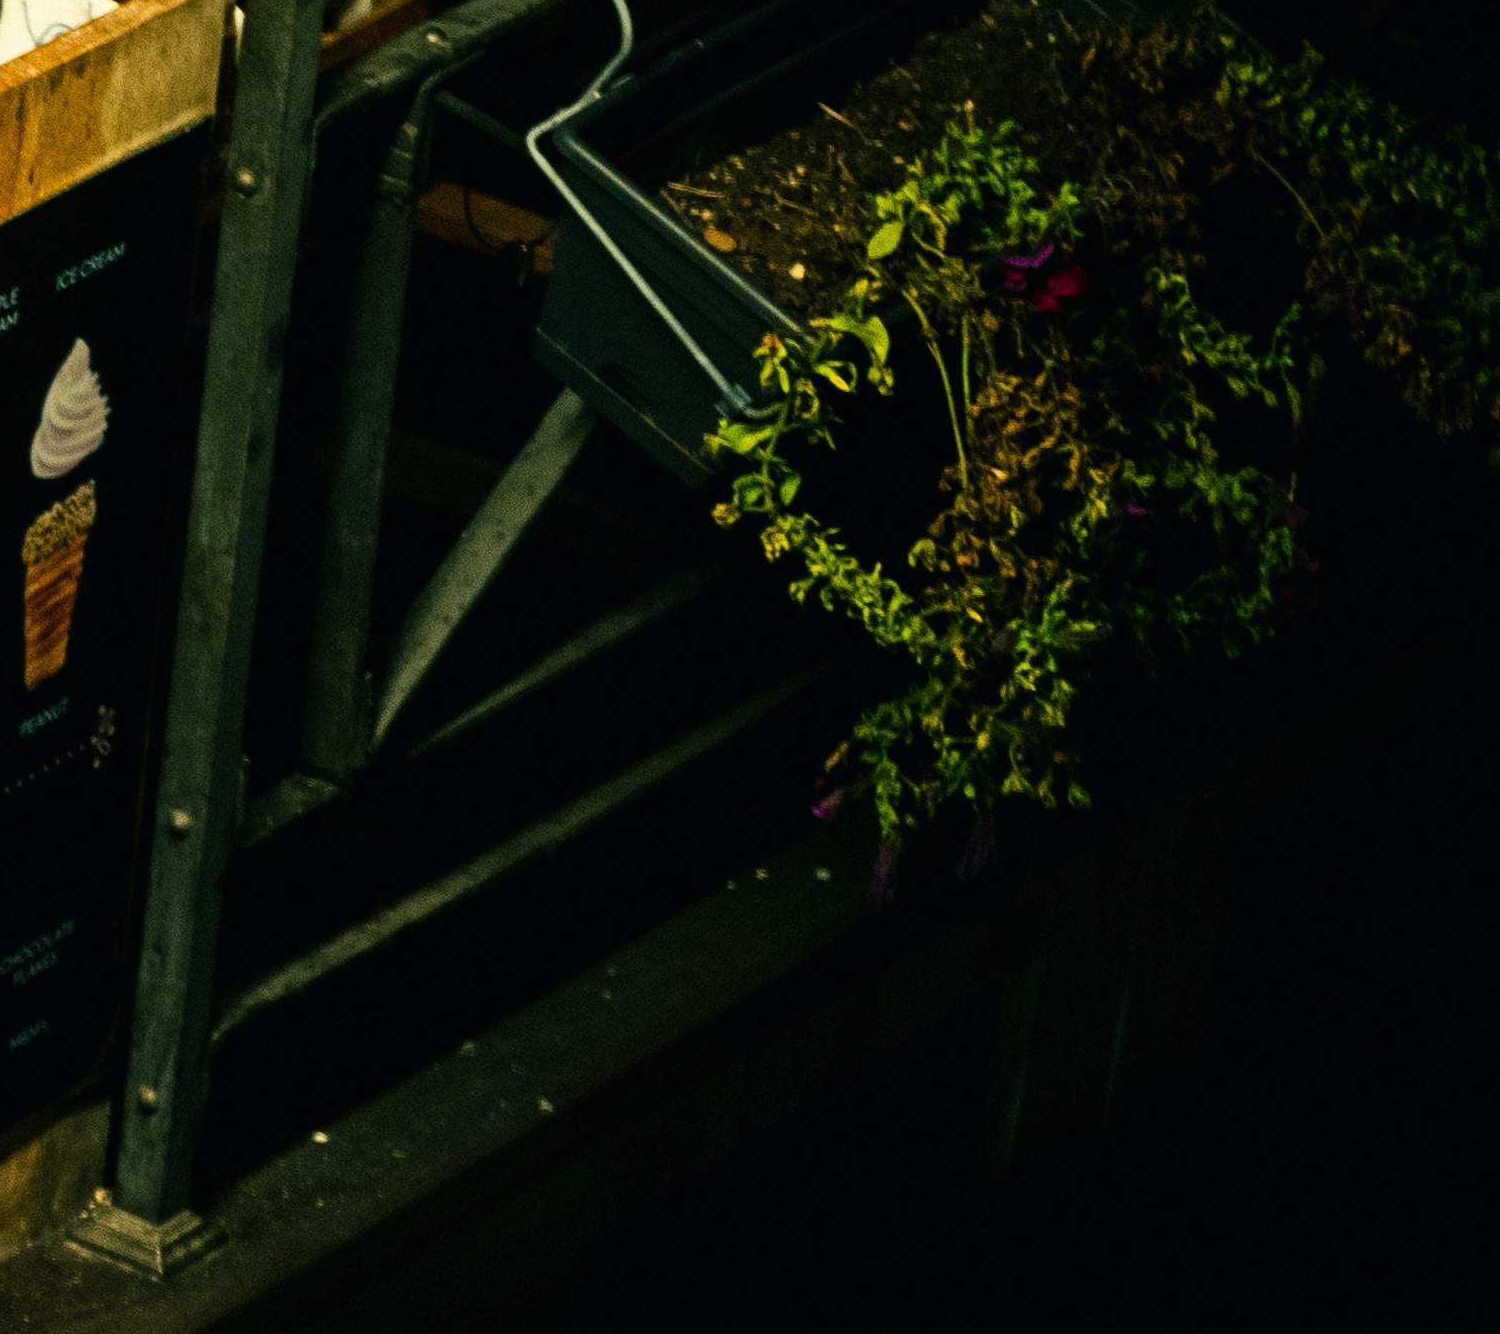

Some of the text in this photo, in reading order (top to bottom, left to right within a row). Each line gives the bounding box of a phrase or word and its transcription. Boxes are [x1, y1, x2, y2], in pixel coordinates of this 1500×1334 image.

[55, 241, 127, 291] ICE CREAM
[18, 696, 71, 738] PEANUT
